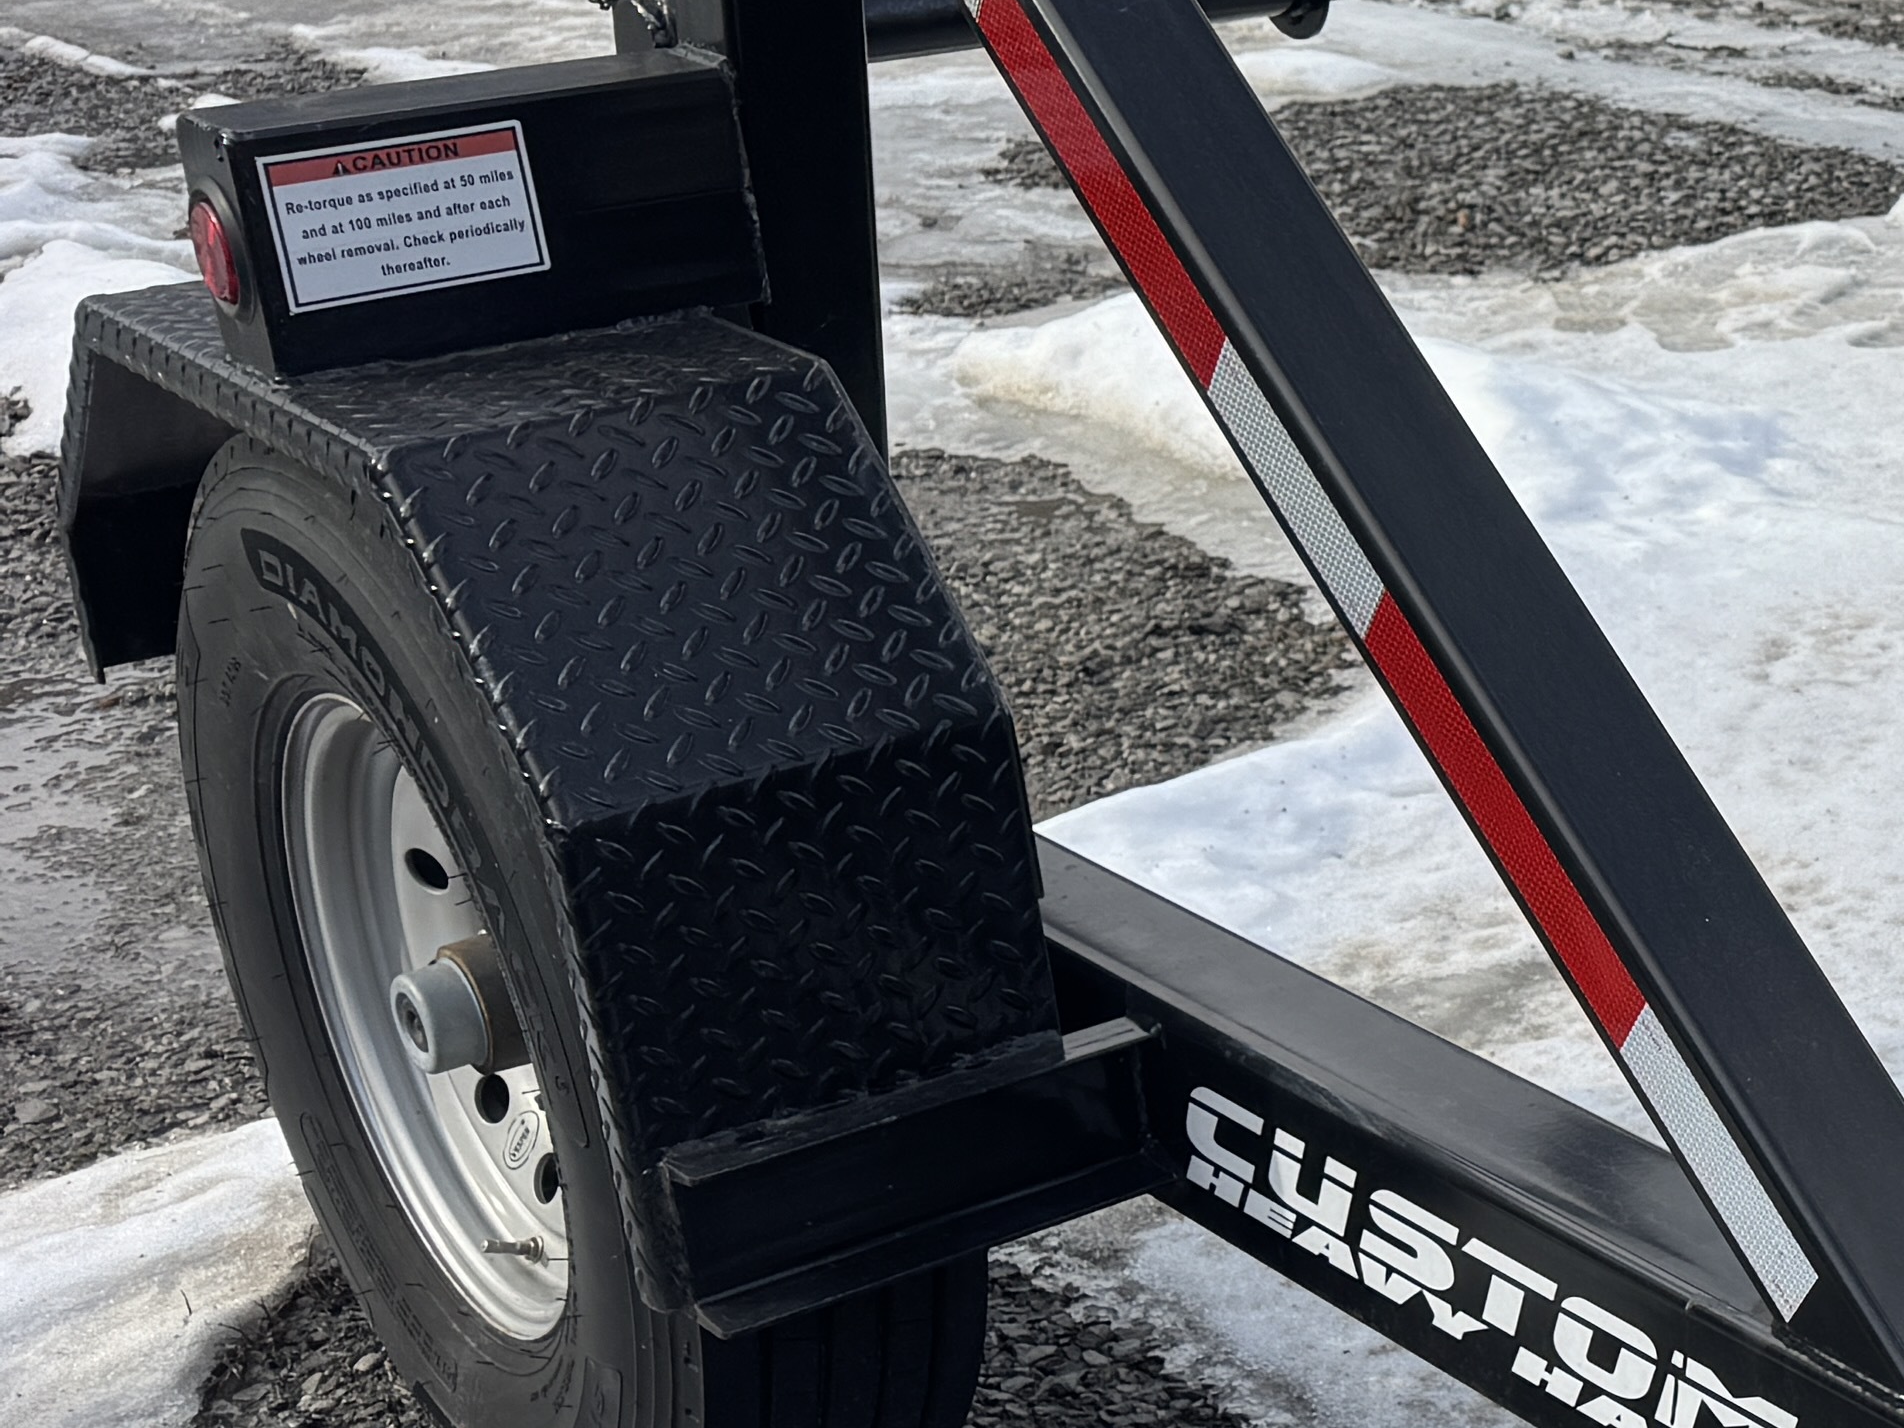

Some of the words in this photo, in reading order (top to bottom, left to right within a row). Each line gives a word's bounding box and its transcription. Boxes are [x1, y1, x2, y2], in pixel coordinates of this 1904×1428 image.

[352, 141, 460, 172] CAUTION
[285, 195, 353, 215] Re-torque
[357, 192, 373, 204] as
[377, 180, 439, 202] specified
[443, 178, 457, 190] at
[459, 174, 476, 187] 50
[479, 169, 514, 185] miles
[301, 225, 327, 240] and
[331, 221, 345, 235] at
[348, 217, 372, 232] 100
[376, 211, 413, 227] miles
[416, 206, 441, 221] and
[445, 201, 475, 216] after
[479, 194, 511, 210] each
[296, 247, 337, 266] wheel
[340, 238, 400, 259] removal.
[403, 229, 445, 248] Check
[449, 218, 526, 243] periodically
[380, 256, 451, 277] thereafter.
[1184, 1154, 1490, 1342] HEAVY
